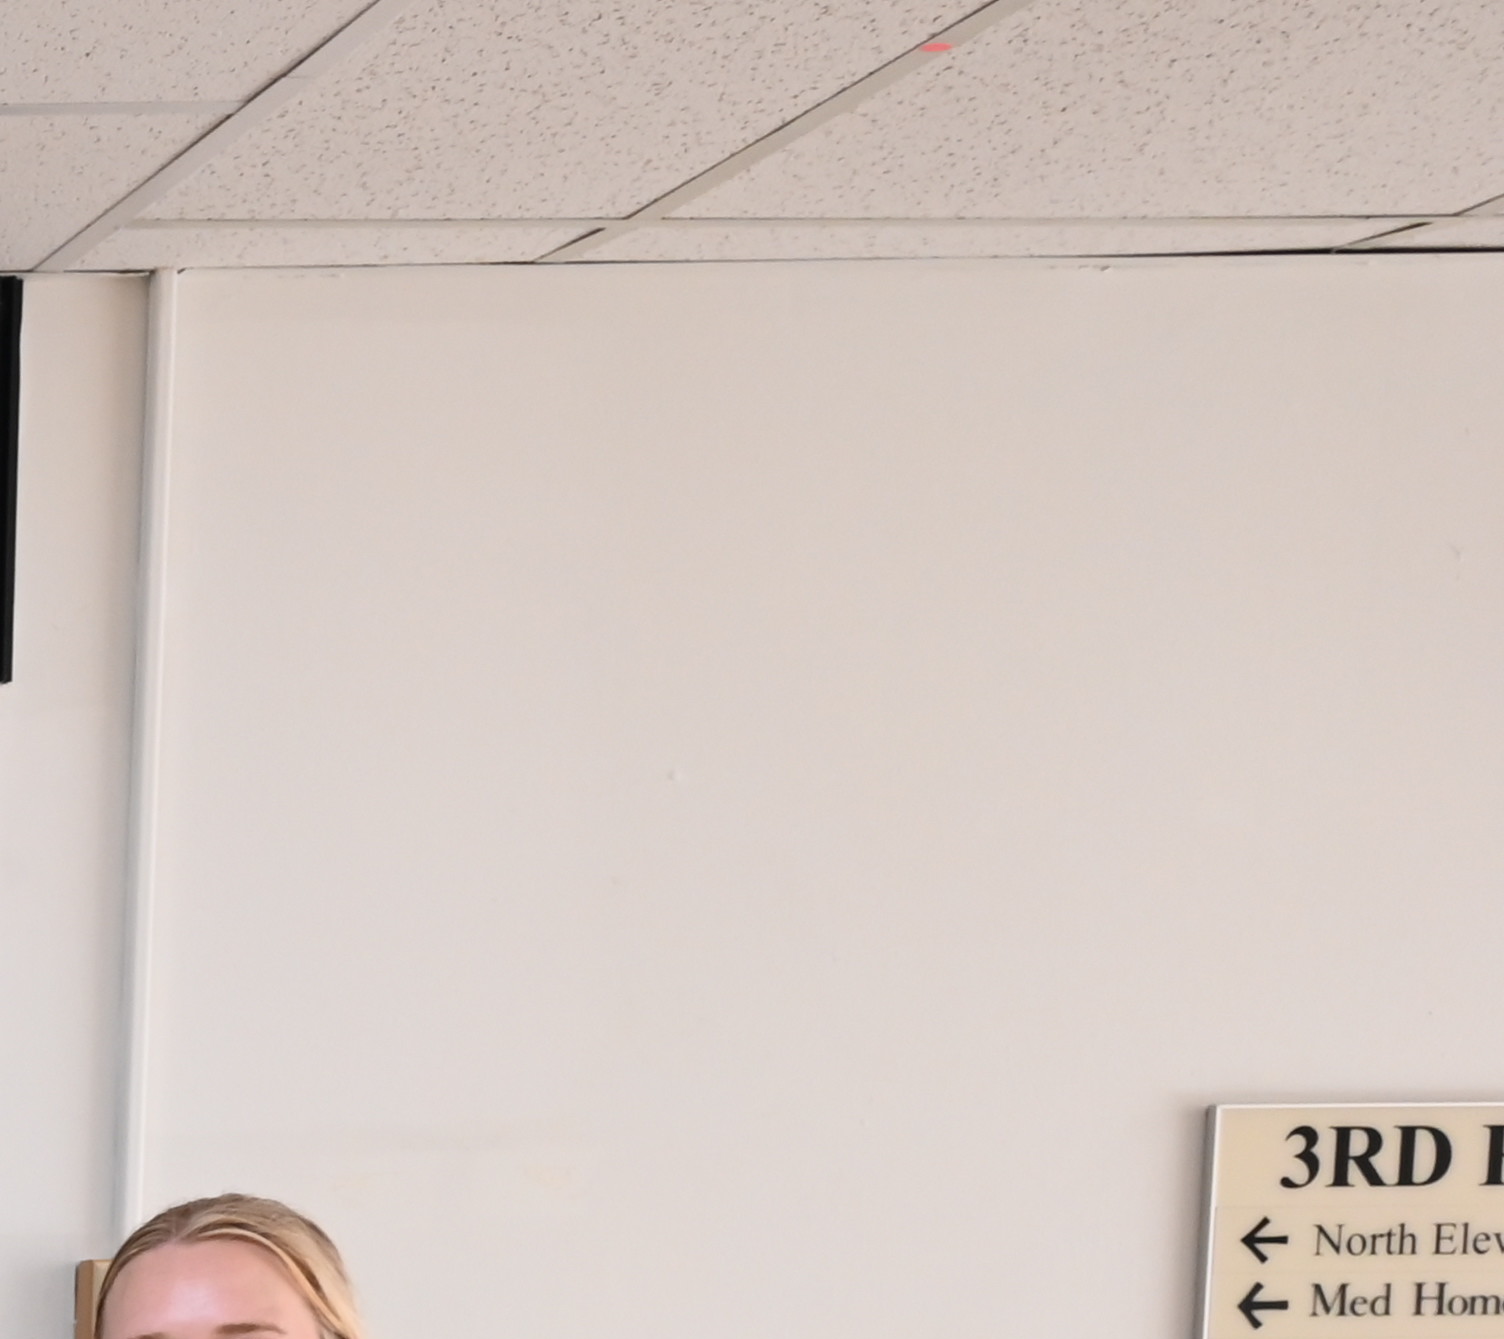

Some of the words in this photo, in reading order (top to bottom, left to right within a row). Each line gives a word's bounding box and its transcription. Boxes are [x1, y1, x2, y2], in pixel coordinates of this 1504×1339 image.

[1280, 1125, 1453, 1188] 3RD
[1313, 1222, 1417, 1256] North
[1309, 1282, 1392, 1317] Med
[1412, 1282, 1504, 1317] Hom
